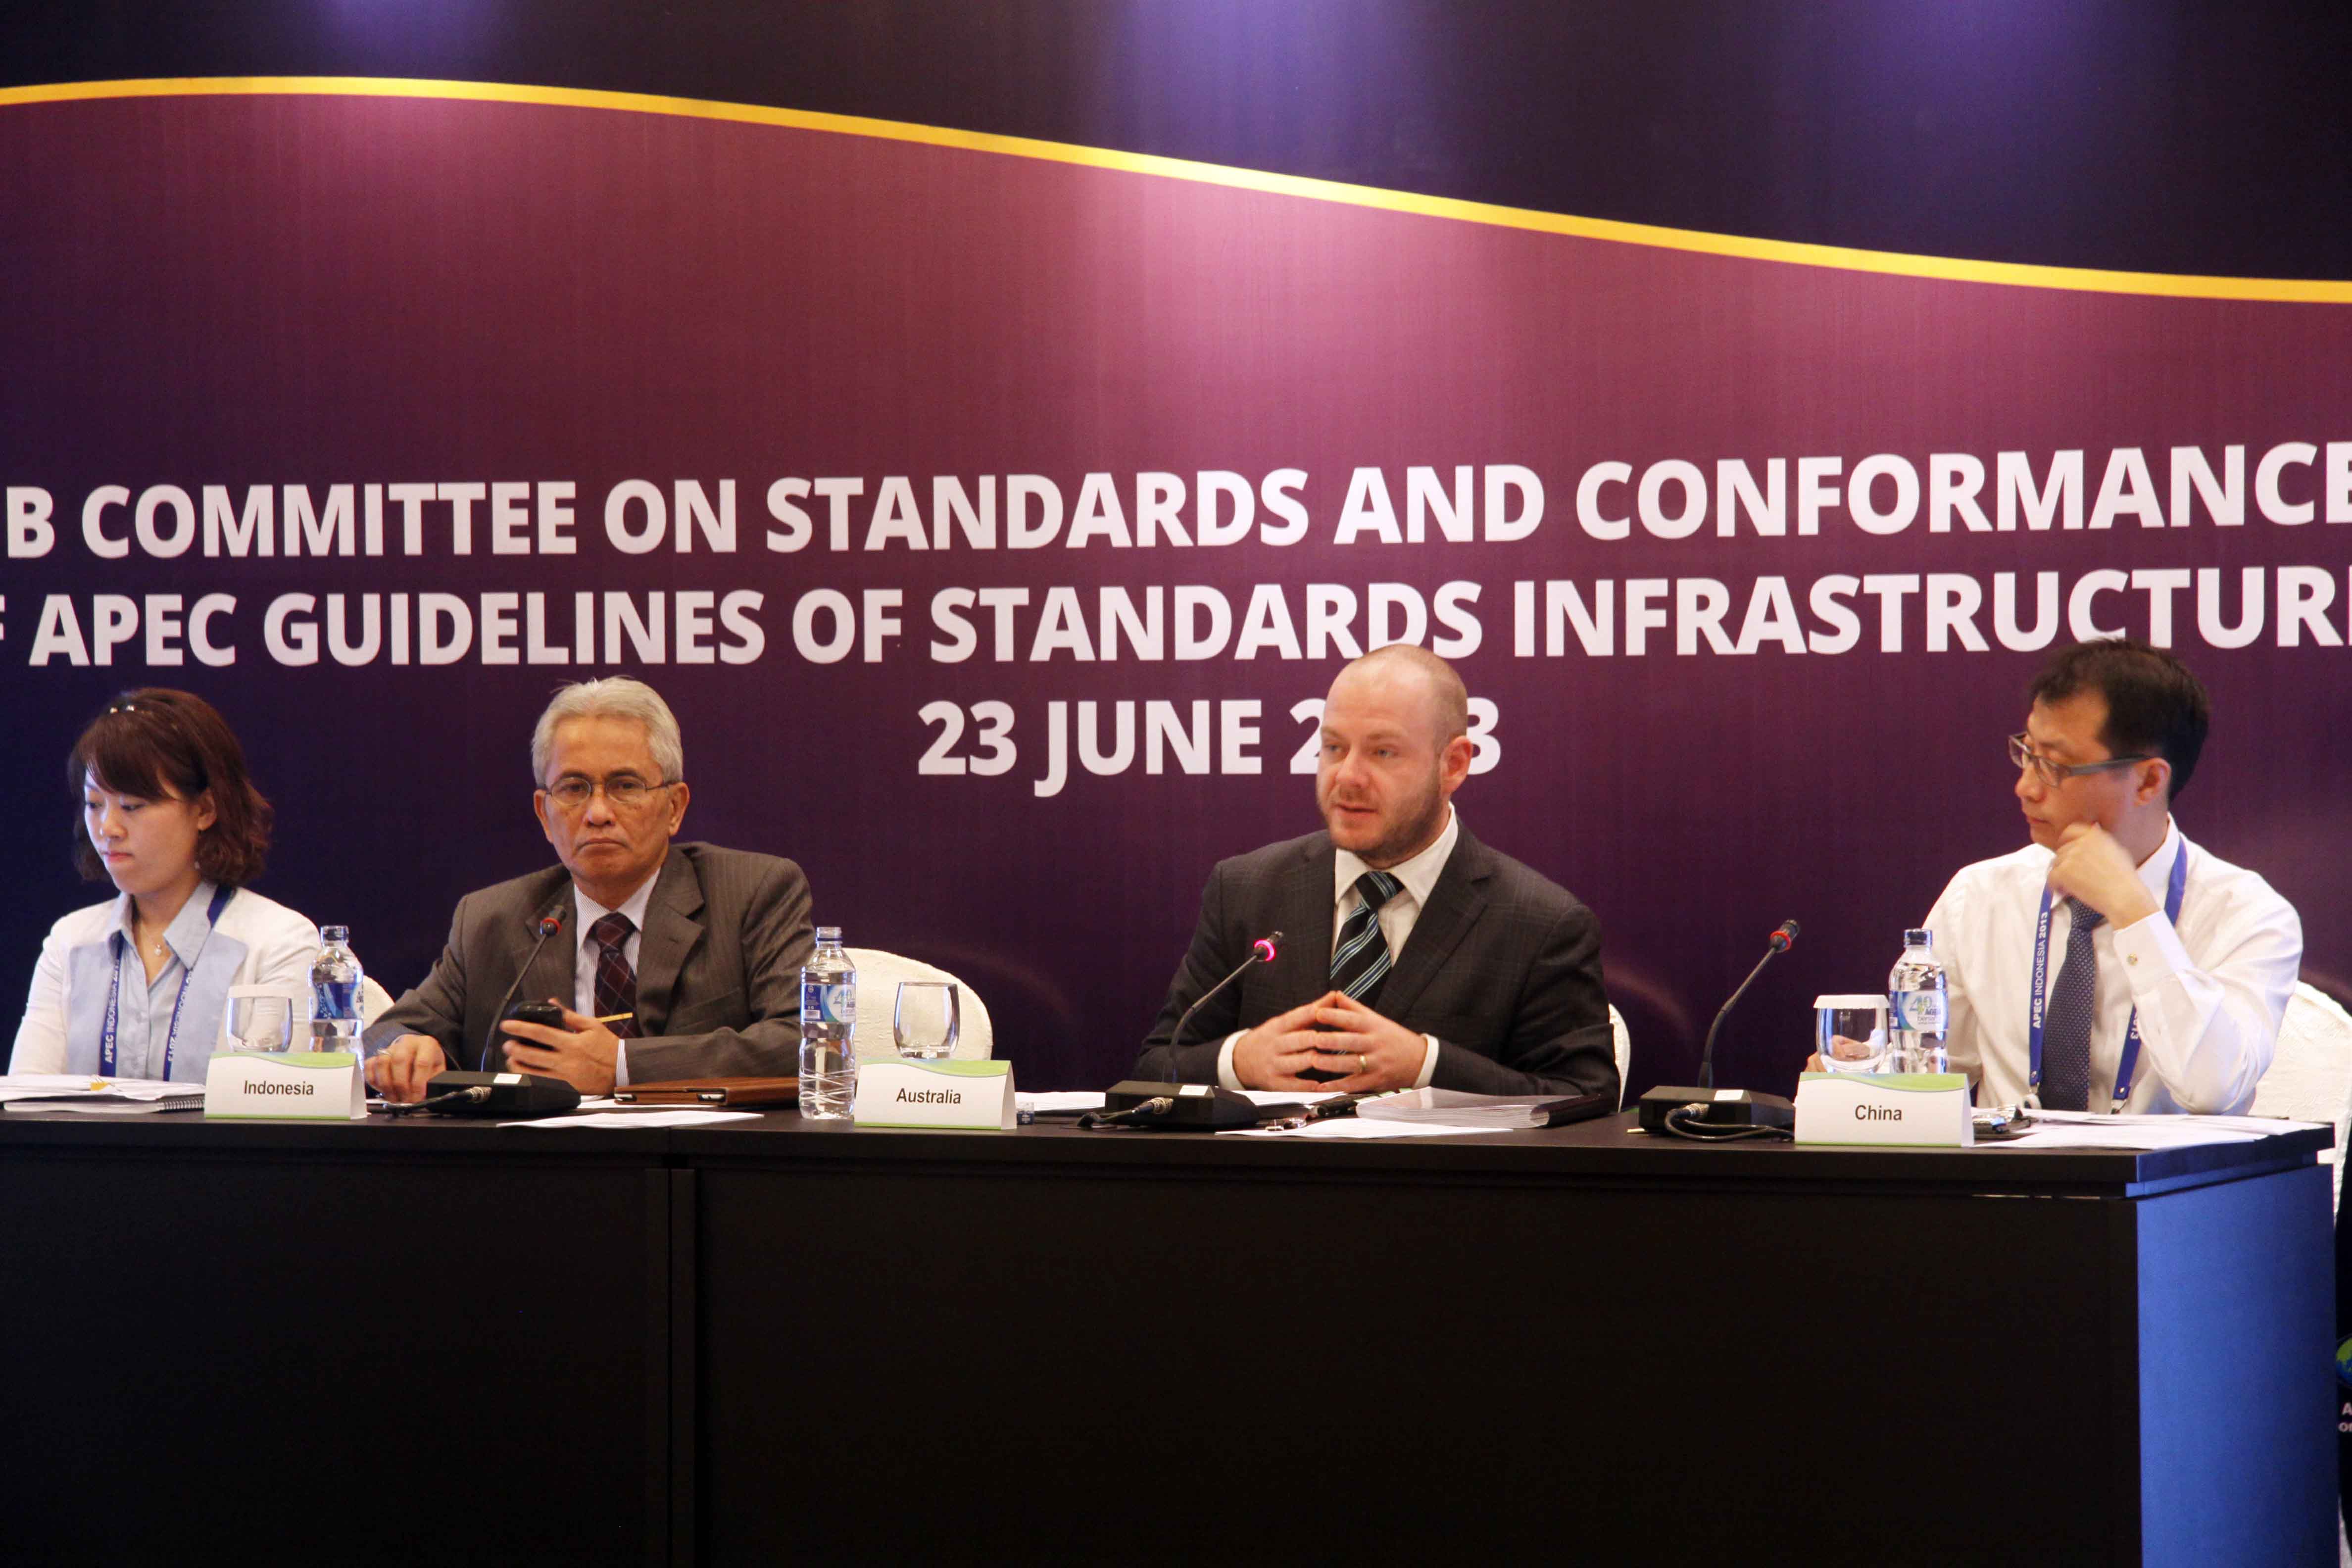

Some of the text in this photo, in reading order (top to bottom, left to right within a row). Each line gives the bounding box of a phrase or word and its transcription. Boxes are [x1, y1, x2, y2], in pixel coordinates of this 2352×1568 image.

[6, 441, 2352, 558] B COMMITTEE ON STANDARDS AND CONFORMANCE
[29, 593, 236, 666] APEC
[264, 590, 765, 666] GUIDELINES
[792, 588, 903, 663] OF
[931, 580, 1482, 663] STANDARDS
[1514, 565, 2352, 657] INFRASTRUCTUR
[918, 697, 1501, 797] 23 JUNE 23
[2033, 911, 2048, 1029] APEC INDONESIA 2013
[104, 1034, 114, 1064] APEC
[244, 1080, 314, 1095] Indonesia
[896, 1087, 961, 1104] Australia
[1855, 1105, 1902, 1121] China
